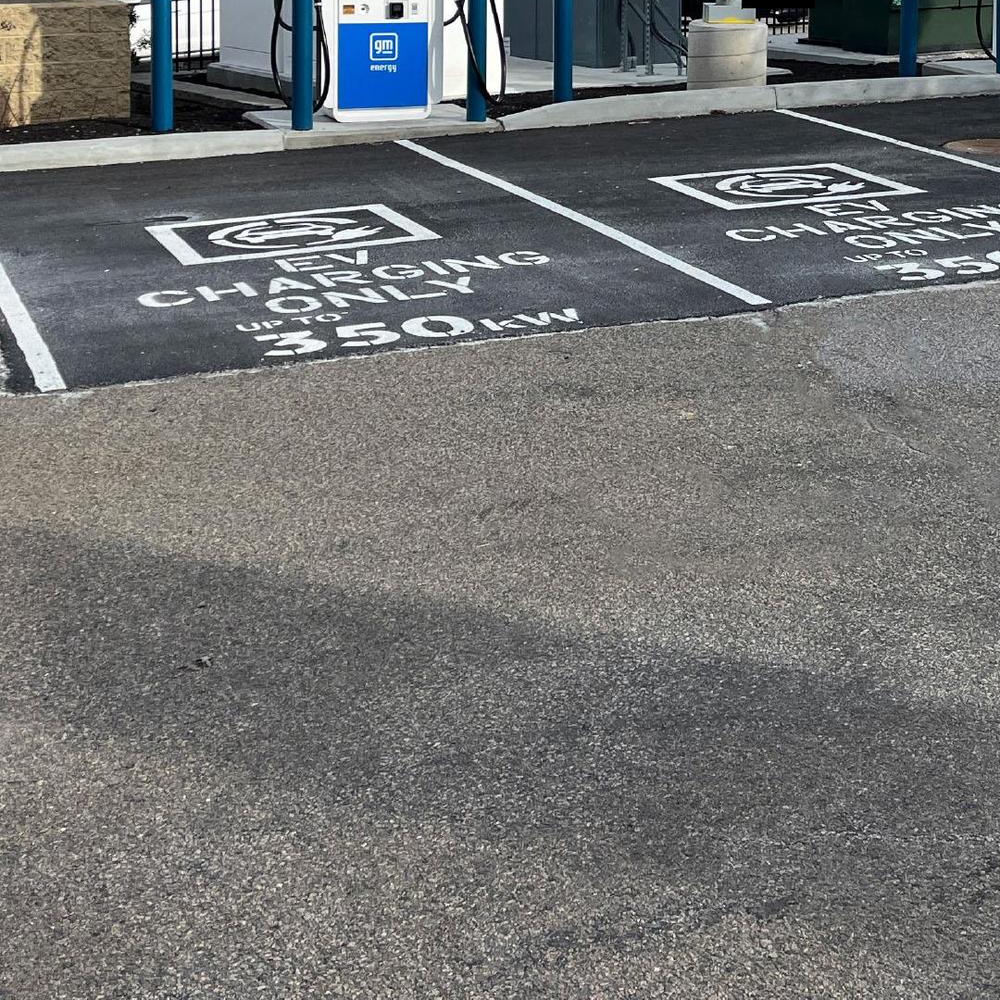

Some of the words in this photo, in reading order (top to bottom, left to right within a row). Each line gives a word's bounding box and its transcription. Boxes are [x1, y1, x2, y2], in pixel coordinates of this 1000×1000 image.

[374, 39, 394, 55] gm
[370, 63, 398, 73] energy
[804, 199, 890, 217] EV
[274, 249, 369, 273] EV
[843, 252, 883, 263] UP
[885, 249, 929, 259] TO
[137, 250, 551, 308] CHARGING
[264, 276, 475, 314] ONLY
[235, 320, 284, 332] UP
[290, 313, 342, 326] TO
